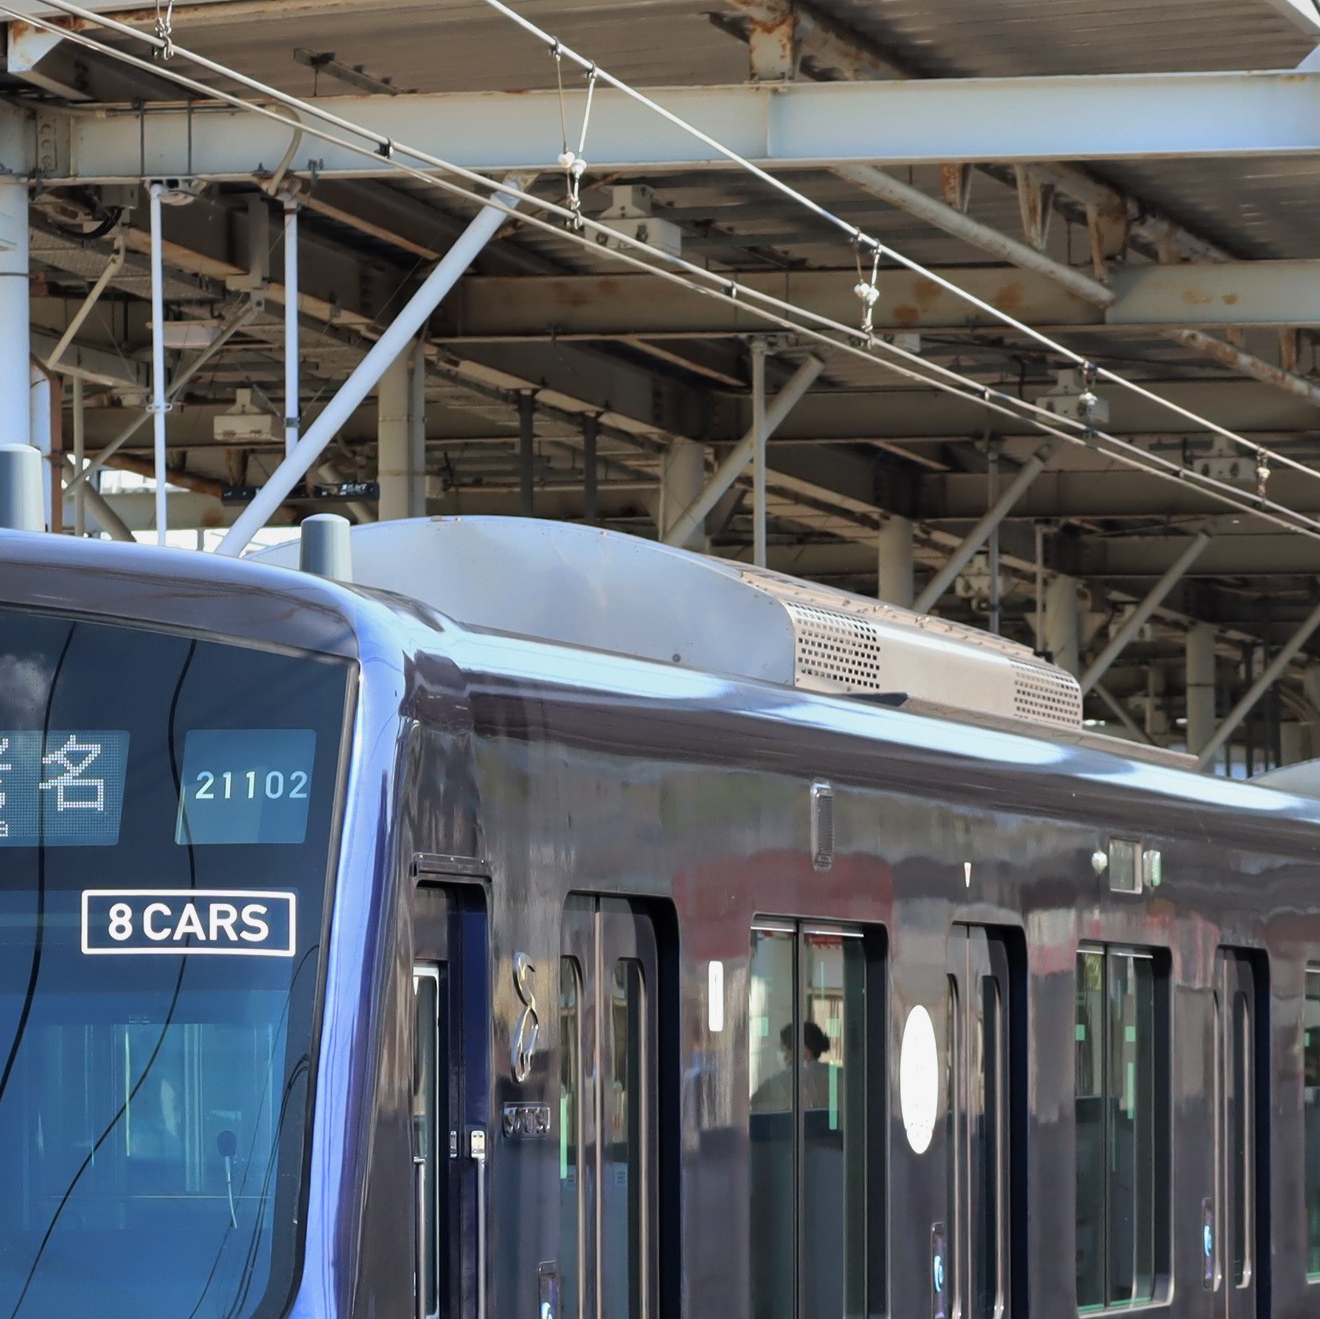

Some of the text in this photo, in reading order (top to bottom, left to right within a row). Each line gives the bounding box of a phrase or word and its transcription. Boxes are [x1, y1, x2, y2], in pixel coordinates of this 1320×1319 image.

[194, 770, 309, 800] 21102
[107, 902, 270, 943] 8 CARS
